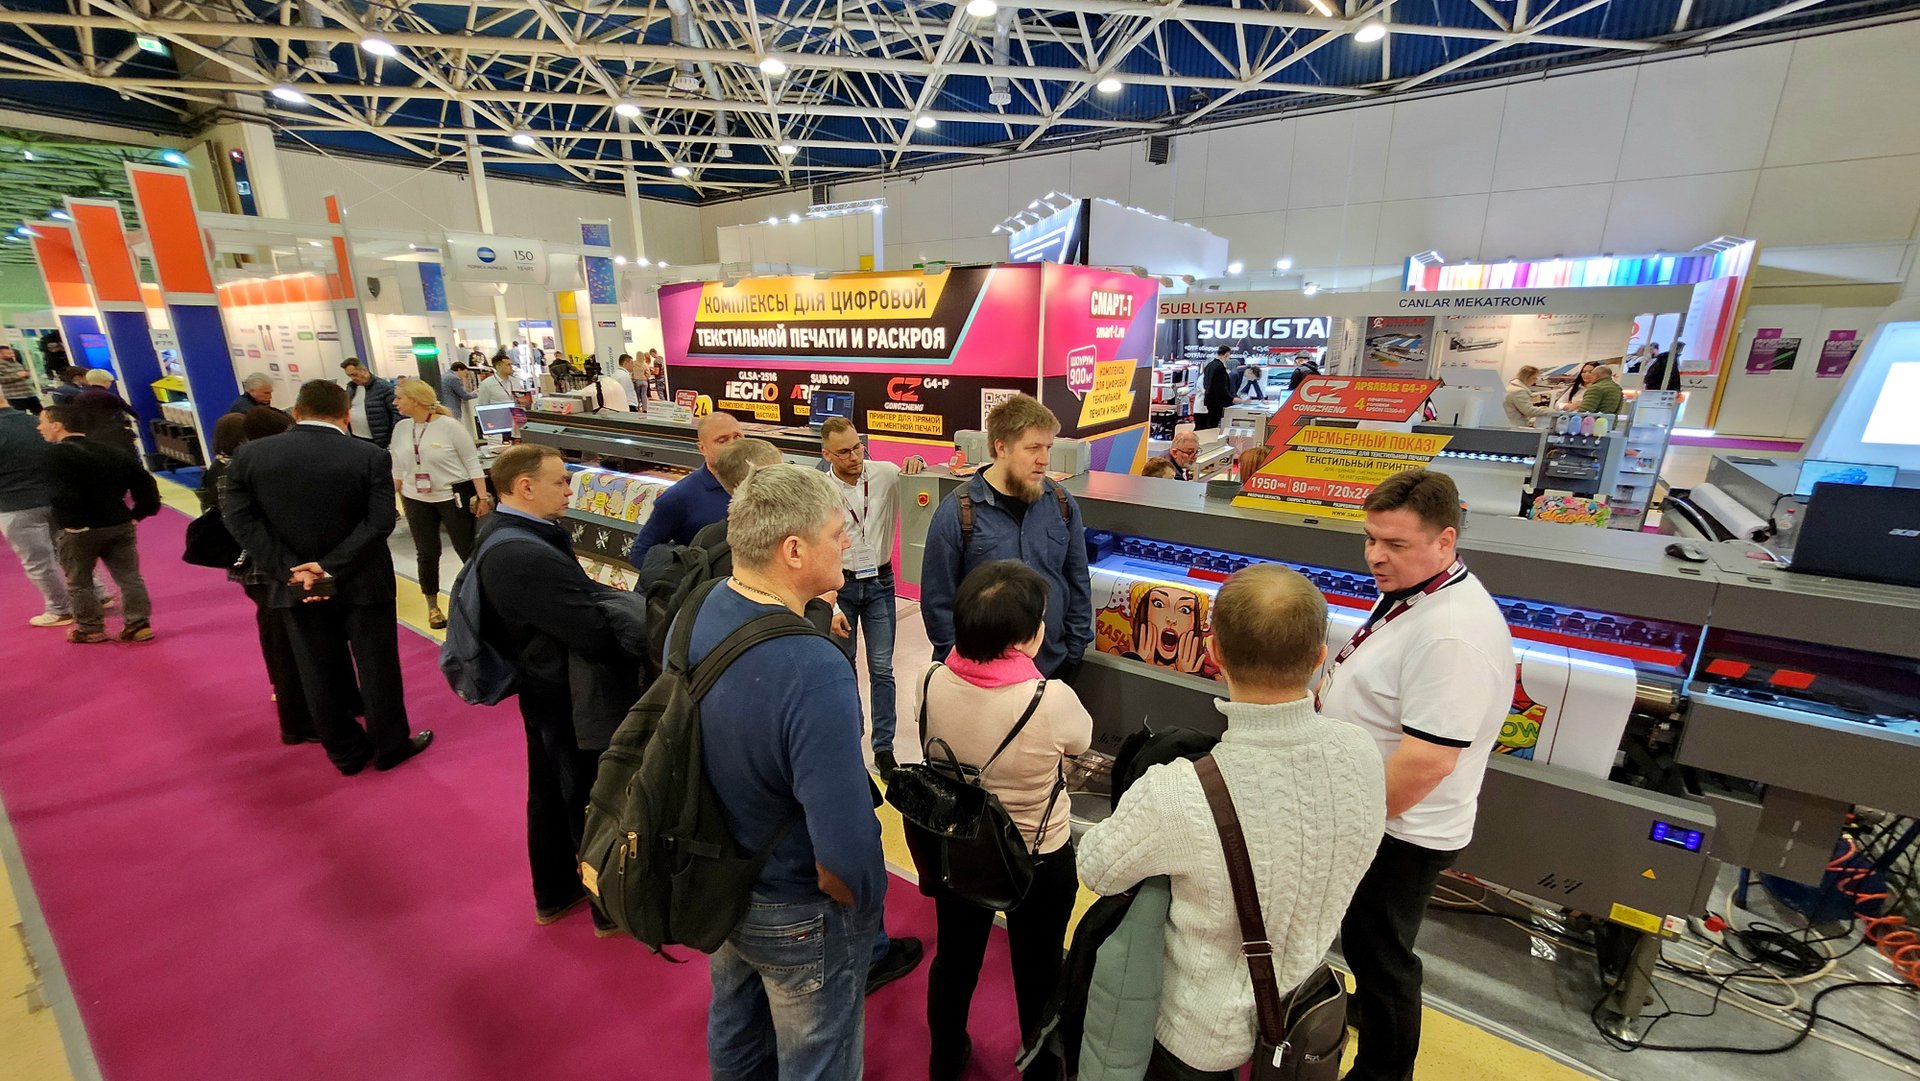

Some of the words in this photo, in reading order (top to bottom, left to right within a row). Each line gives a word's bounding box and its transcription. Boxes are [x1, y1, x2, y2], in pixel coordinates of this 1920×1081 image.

[704, 293, 789, 314] КОМПЛЕКСЫ
[794, 291, 826, 315] ДЛЯ
[831, 282, 927, 314] ЦИФРОВОЙ
[1090, 290, 1133, 317] СМАРТ-Т
[1399, 298, 1451, 308] CANLAR
[1454, 295, 1547, 308] MEKATRONIK
[1160, 301, 1248, 315] SUBLISTAR
[696, 323, 788, 348] ТЕКСТИЛЬНОЙ
[790, 327, 847, 349] ПЕЧАТИ
[851, 327, 863, 349] И
[867, 327, 946, 350] РАСКРОЯ
[1070, 355, 1094, 367] ШОУРУМ
[738, 371, 778, 382] GLSA-2516
[810, 373, 828, 384] SUB
[828, 374, 850, 385] 1900
[1353, 381, 1400, 393] APSARAS
[884, 402, 925, 411] GONGZHENG
[1292, 403, 1348, 414] GONGZHENG
[1353, 397, 1366, 411] 4
[869, 411, 897, 421] ПРИНТЕР
[897, 413, 912, 423] ДЛЯ
[912, 413, 941, 424] ПРЯМОЙ
[872, 420, 914, 431] ПИГМЕНТНОЙ
[914, 424, 941, 433] ПЕЧАТИ
[1302, 429, 1387, 448] ПРЕМЬЕРНЫЙ
[1390, 437, 1436, 452] ПОКАЗ!
[1305, 456, 1373, 469] ТЕКСТИЛЬНЫЙ
